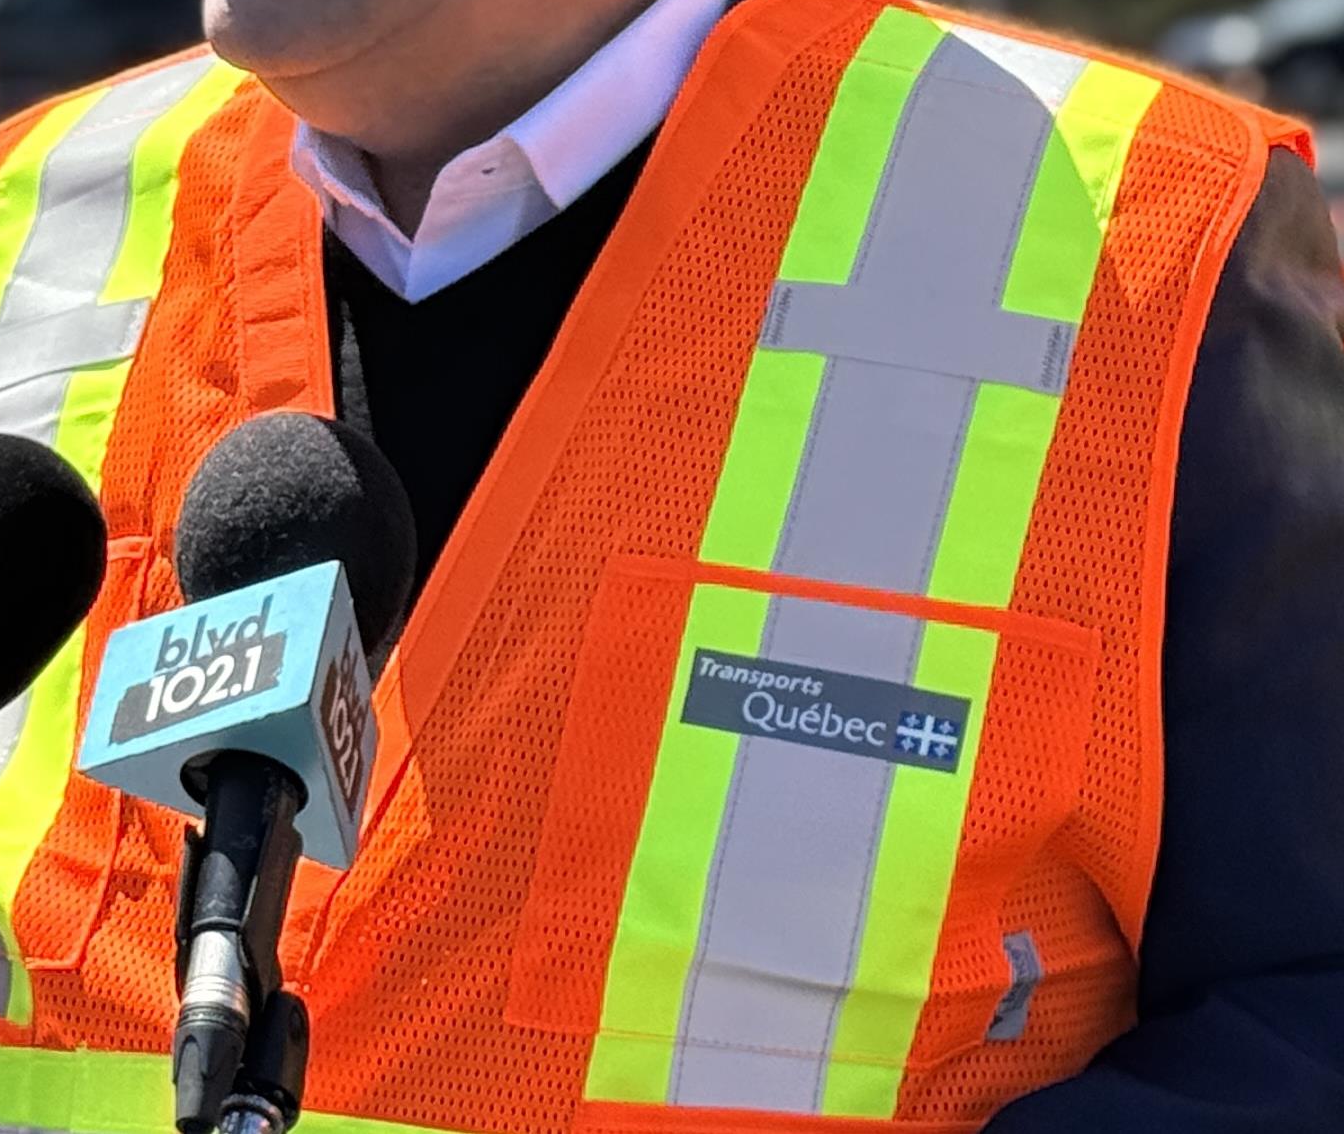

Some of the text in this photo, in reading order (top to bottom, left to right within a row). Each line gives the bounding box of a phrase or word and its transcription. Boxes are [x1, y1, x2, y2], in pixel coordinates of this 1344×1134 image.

[156, 593, 274, 669] blvd
[146, 644, 263, 723] 102.1
[699, 656, 824, 697] Transports
[742, 691, 887, 747] Québec
